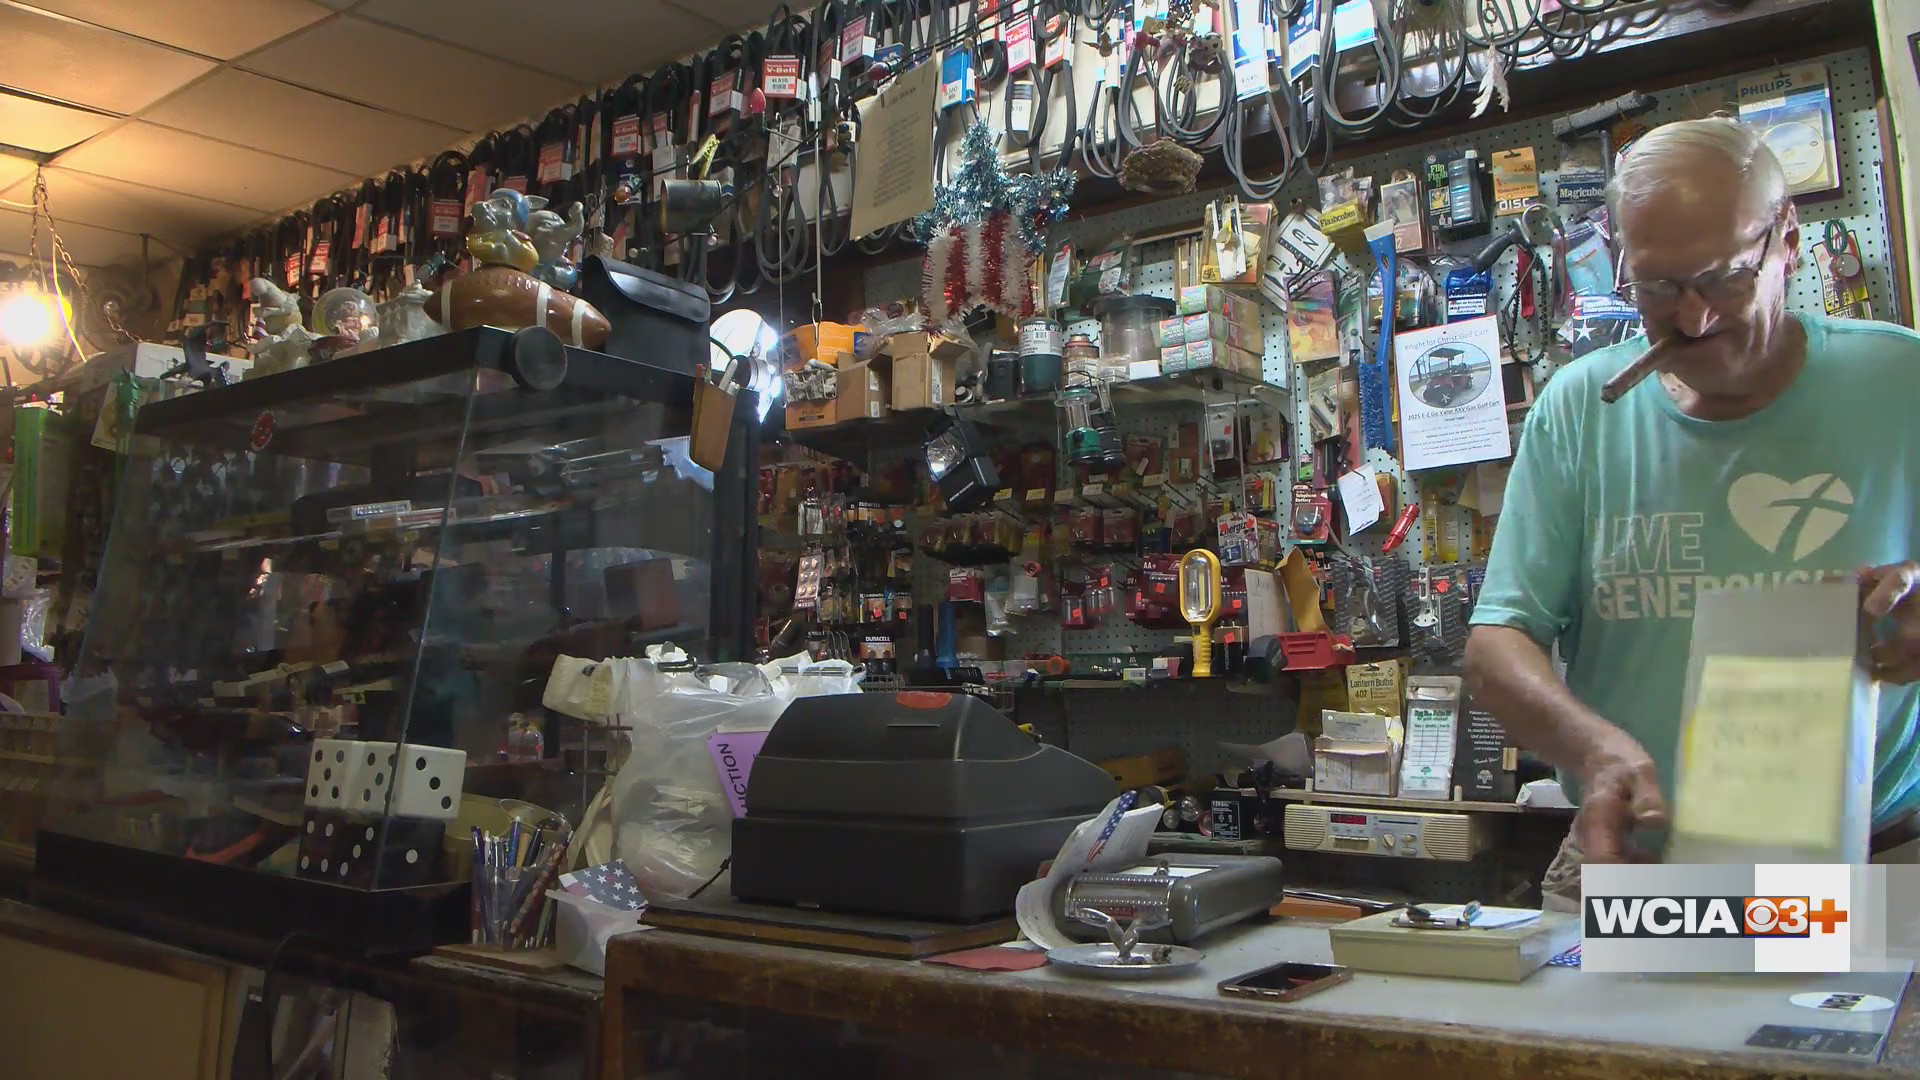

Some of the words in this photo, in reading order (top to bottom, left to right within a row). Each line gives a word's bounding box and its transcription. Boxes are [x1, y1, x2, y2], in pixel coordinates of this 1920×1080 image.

[1741, 79, 1793, 97] PHILIPS
[1431, 164, 1445, 173] Flip
[1428, 171, 1448, 181] Flash
[1320, 210, 1356, 226] Flashcubes
[1292, 228, 1319, 251] EZ
[1024, 324, 1047, 332] PROPANE
[1405, 342, 1425, 351] Knight
[1438, 335, 1457, 344] Christ
[1593, 512, 1704, 575] LIVE
[1351, 680, 1375, 688] Lantern
[1376, 678, 1393, 687] Bulbs
[1355, 690, 1367, 699] 407
